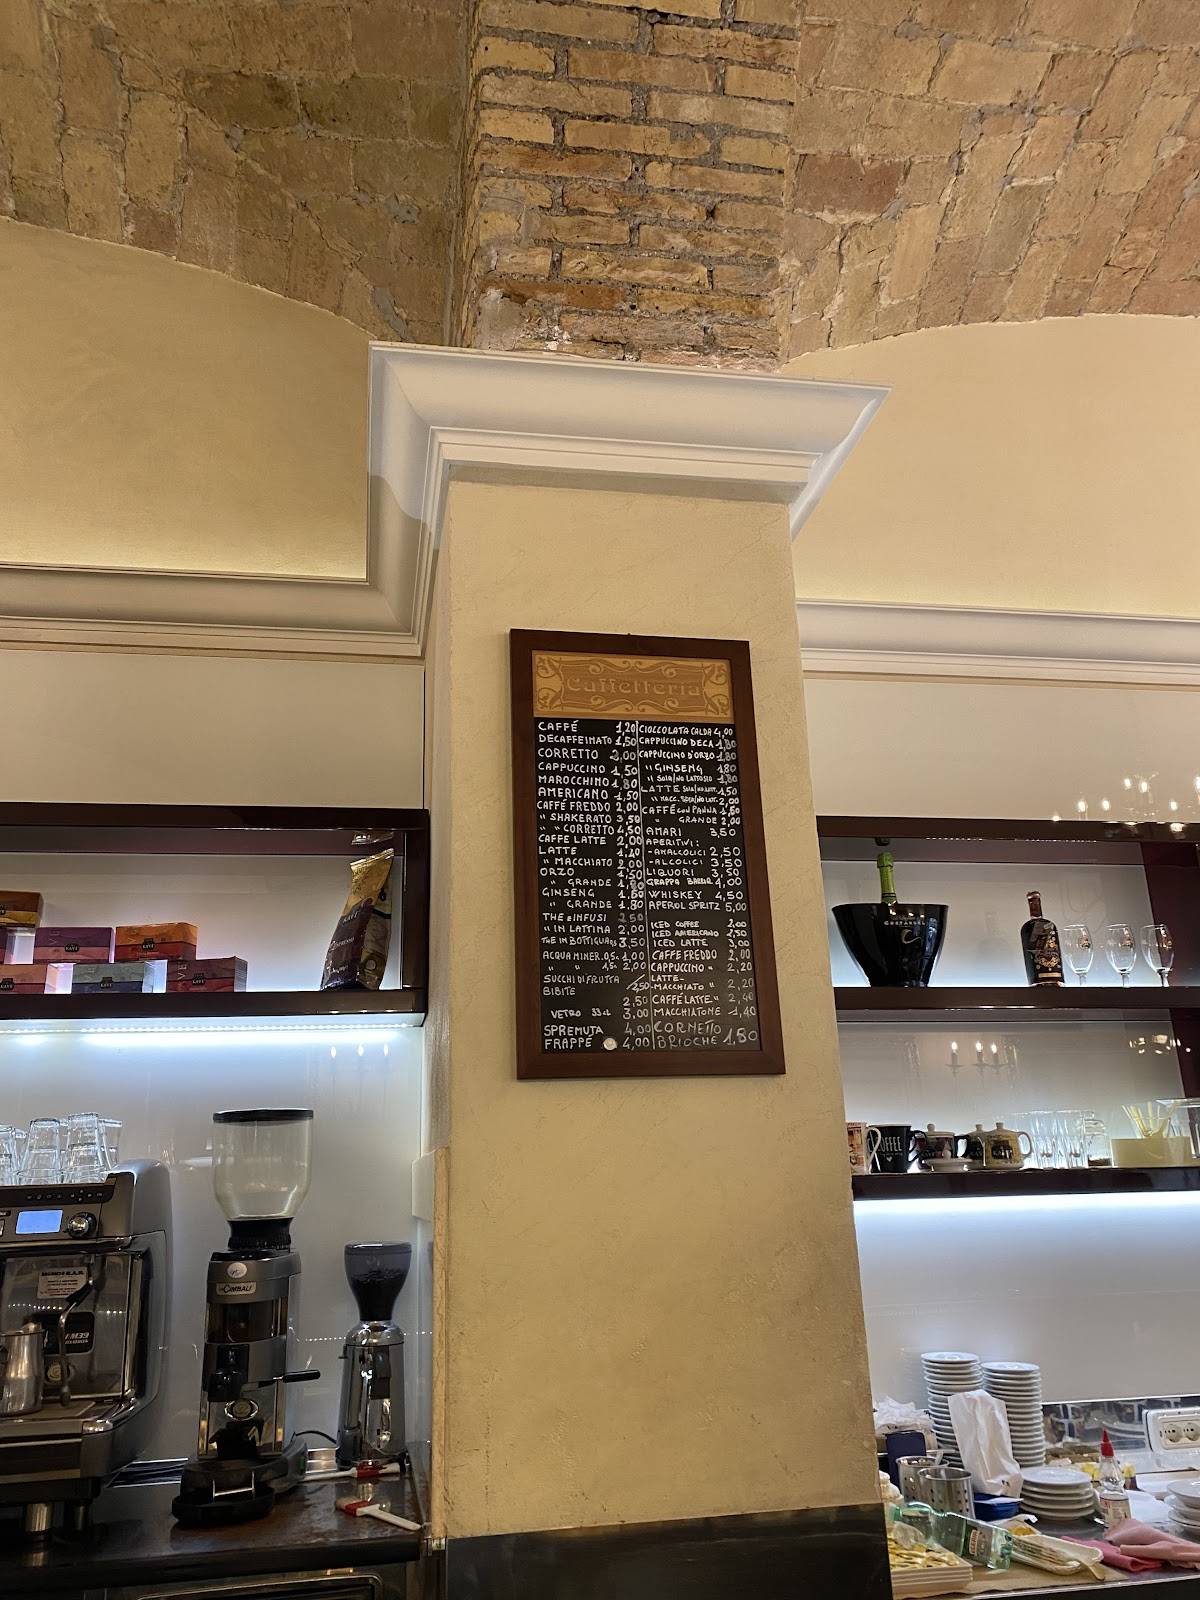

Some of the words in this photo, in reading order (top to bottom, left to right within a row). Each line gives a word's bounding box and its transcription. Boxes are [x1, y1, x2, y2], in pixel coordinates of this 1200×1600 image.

[567, 678, 700, 697] Caffetteria
[538, 720, 579, 732] CAFFÉ
[616, 721, 636, 736] 1,20
[639, 725, 689, 735] CIOCCOLATA
[691, 727, 712, 736] CALDA
[714, 728, 733, 739] 4,00
[539, 734, 613, 745] DECAFFEINATO
[615, 735, 637, 747] 1,50
[639, 737, 688, 746] CAPPUCCINO
[690, 739, 714, 748] DECA
[538, 747, 599, 760] CORRETTO
[609, 749, 636, 763] 2,00
[639, 750, 685, 759] CAPPUCCINO
[538, 761, 606, 774] CAPPUCCINO
[611, 764, 638, 779] 1,50
[655, 763, 703, 775] GINSENG
[538, 775, 610, 787] MAROCCHINO
[538, 787, 609, 800] AMERICANO
[614, 790, 639, 802] 1,50
[641, 785, 680, 793] LATTE
[717, 786, 738, 796] 1,50
[536, 798, 568, 811] CAFFÉ
[569, 801, 611, 812] FREDDO
[615, 801, 639, 814] 2,00
[719, 797, 740, 808] 2,00
[642, 804, 676, 814] CAFFÉ
[692, 805, 717, 814] PANNA
[549, 813, 612, 824] SHAKERATO
[678, 816, 717, 824] GRANDE
[721, 817, 741, 827] 2,00
[563, 824, 615, 835] CORRETTO
[616, 825, 641, 837] 4,50
[646, 827, 682, 836] AMARI
[710, 827, 736, 838] 3,50
[573, 835, 607, 845] LATTE
[616, 835, 643, 849] 2,00
[538, 846, 578, 855] LATTE
[710, 847, 741, 860] 2,50
[554, 857, 613, 867] MACCHIATO
[711, 858, 743, 868] 3,50
[539, 867, 575, 876] ORZO
[616, 869, 643, 880] 1,50
[646, 868, 694, 877] LIQUORI
[711, 868, 740, 878] 3,50
[567, 878, 612, 887] GRANDE
[646, 878, 680, 886] GRAPPA
[715, 877, 743, 889] 4,00
[542, 887, 595, 898] GINSENG
[648, 890, 702, 899] WHISKEY
[715, 891, 743, 902] 4,50
[566, 899, 613, 909] GRANDE
[618, 900, 644, 911] 1,80
[649, 901, 686, 911] APEROL
[688, 901, 721, 911] SPRITZ
[725, 902, 747, 913] 5,00
[542, 912, 564, 921] THE
[573, 913, 607, 922] INFUSI
[651, 921, 671, 929] ICED
[675, 920, 700, 928] COFFEE
[727, 918, 747, 928] 2,00
[569, 924, 611, 934] LATTINA
[618, 924, 645, 936] 2,00
[651, 930, 671, 938] ICED
[674, 929, 719, 937] AMERICANO
[618, 937, 645, 949] 3,50
[653, 939, 676, 947] ICED
[680, 938, 709, 947] LATTE
[542, 950, 571, 960] ACQUA
[621, 951, 645, 964] 1,00
[683, 949, 718, 960] FREDDO
[623, 961, 647, 972] 2,00
[650, 962, 705, 973] CAPPUCCINO
[727, 962, 753, 974] 2,20
[543, 974, 575, 984] SUCCHI
[586, 975, 620, 984] FRUTTA
[728, 978, 754, 991] 2,20
[543, 986, 576, 996] BIBITE
[623, 995, 648, 1007] 2,50
[652, 992, 683, 1004] CAFFÉ
[684, 995, 713, 1004] LATTE
[550, 1009, 582, 1019] VETRO
[623, 1007, 649, 1020] 3,00
[654, 1007, 721, 1016] MACCHIATONE
[544, 1024, 604, 1037] SPREMUTA
[624, 1022, 651, 1036] 4,00
[654, 1019, 722, 1034] CORNETTO
[622, 1037, 650, 1051] 4,00
[657, 1035, 717, 1049] BRIOCHE
